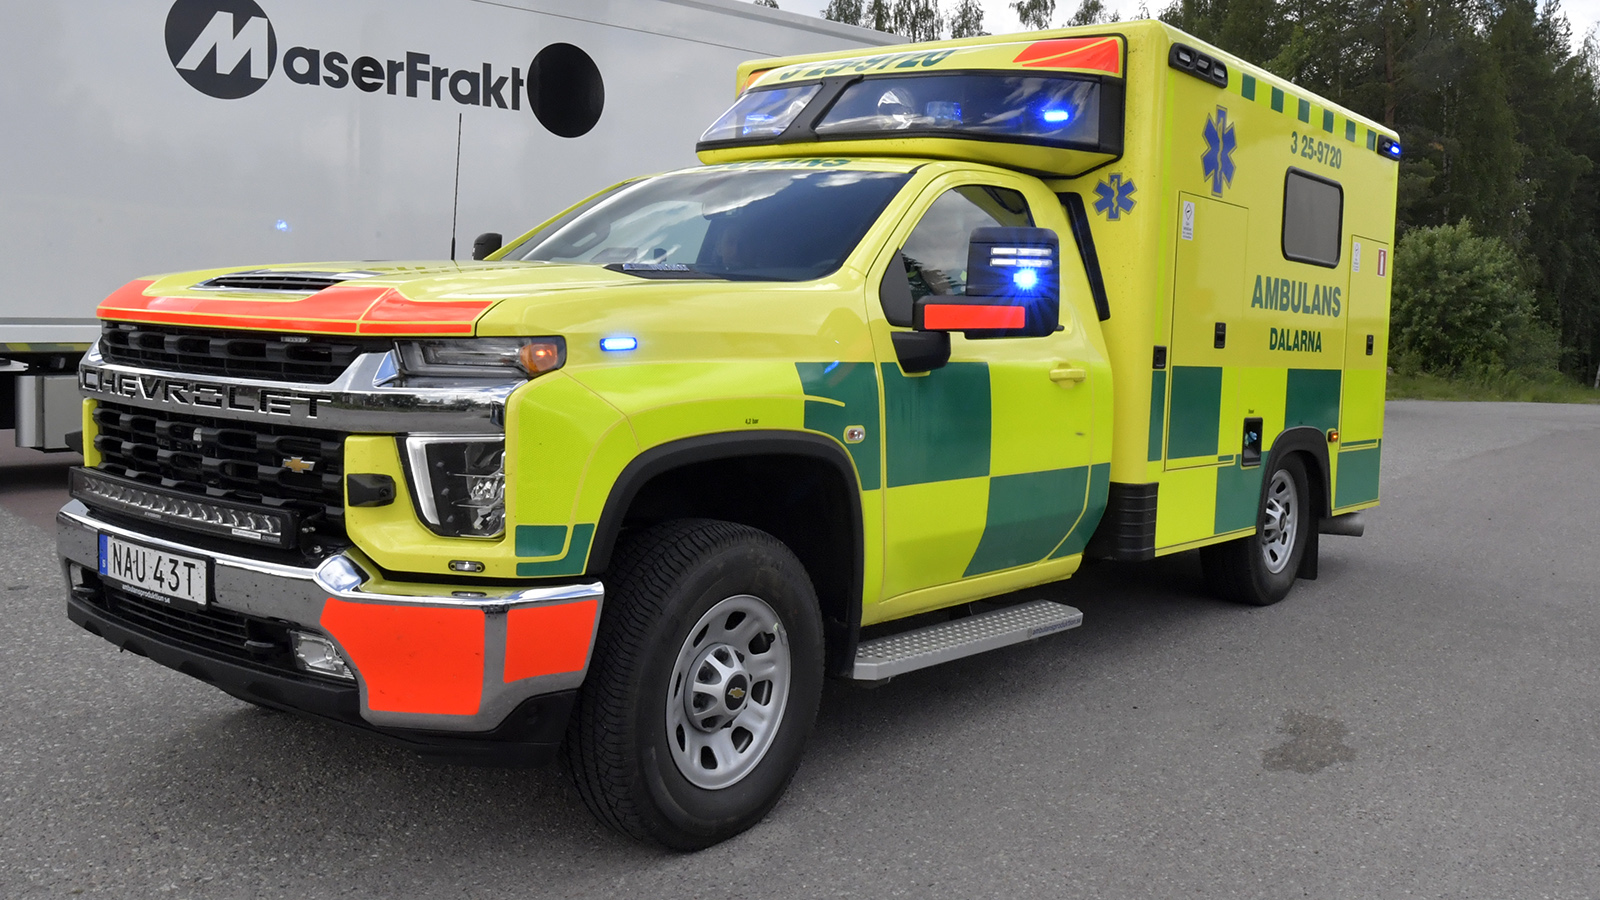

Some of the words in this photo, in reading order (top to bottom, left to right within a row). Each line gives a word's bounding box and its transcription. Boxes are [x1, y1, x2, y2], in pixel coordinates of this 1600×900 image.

[175, 10, 524, 111] MaserFrakt
[1290, 130, 1298, 154] 3
[1300, 135, 1342, 169] 25-9720
[1250, 274, 1341, 318] AMBULANS
[1269, 327, 1322, 353] DALARNA
[81, 368, 332, 419] CHEVROLET
[113, 542, 146, 582] NAU
[153, 555, 196, 596] 43T
